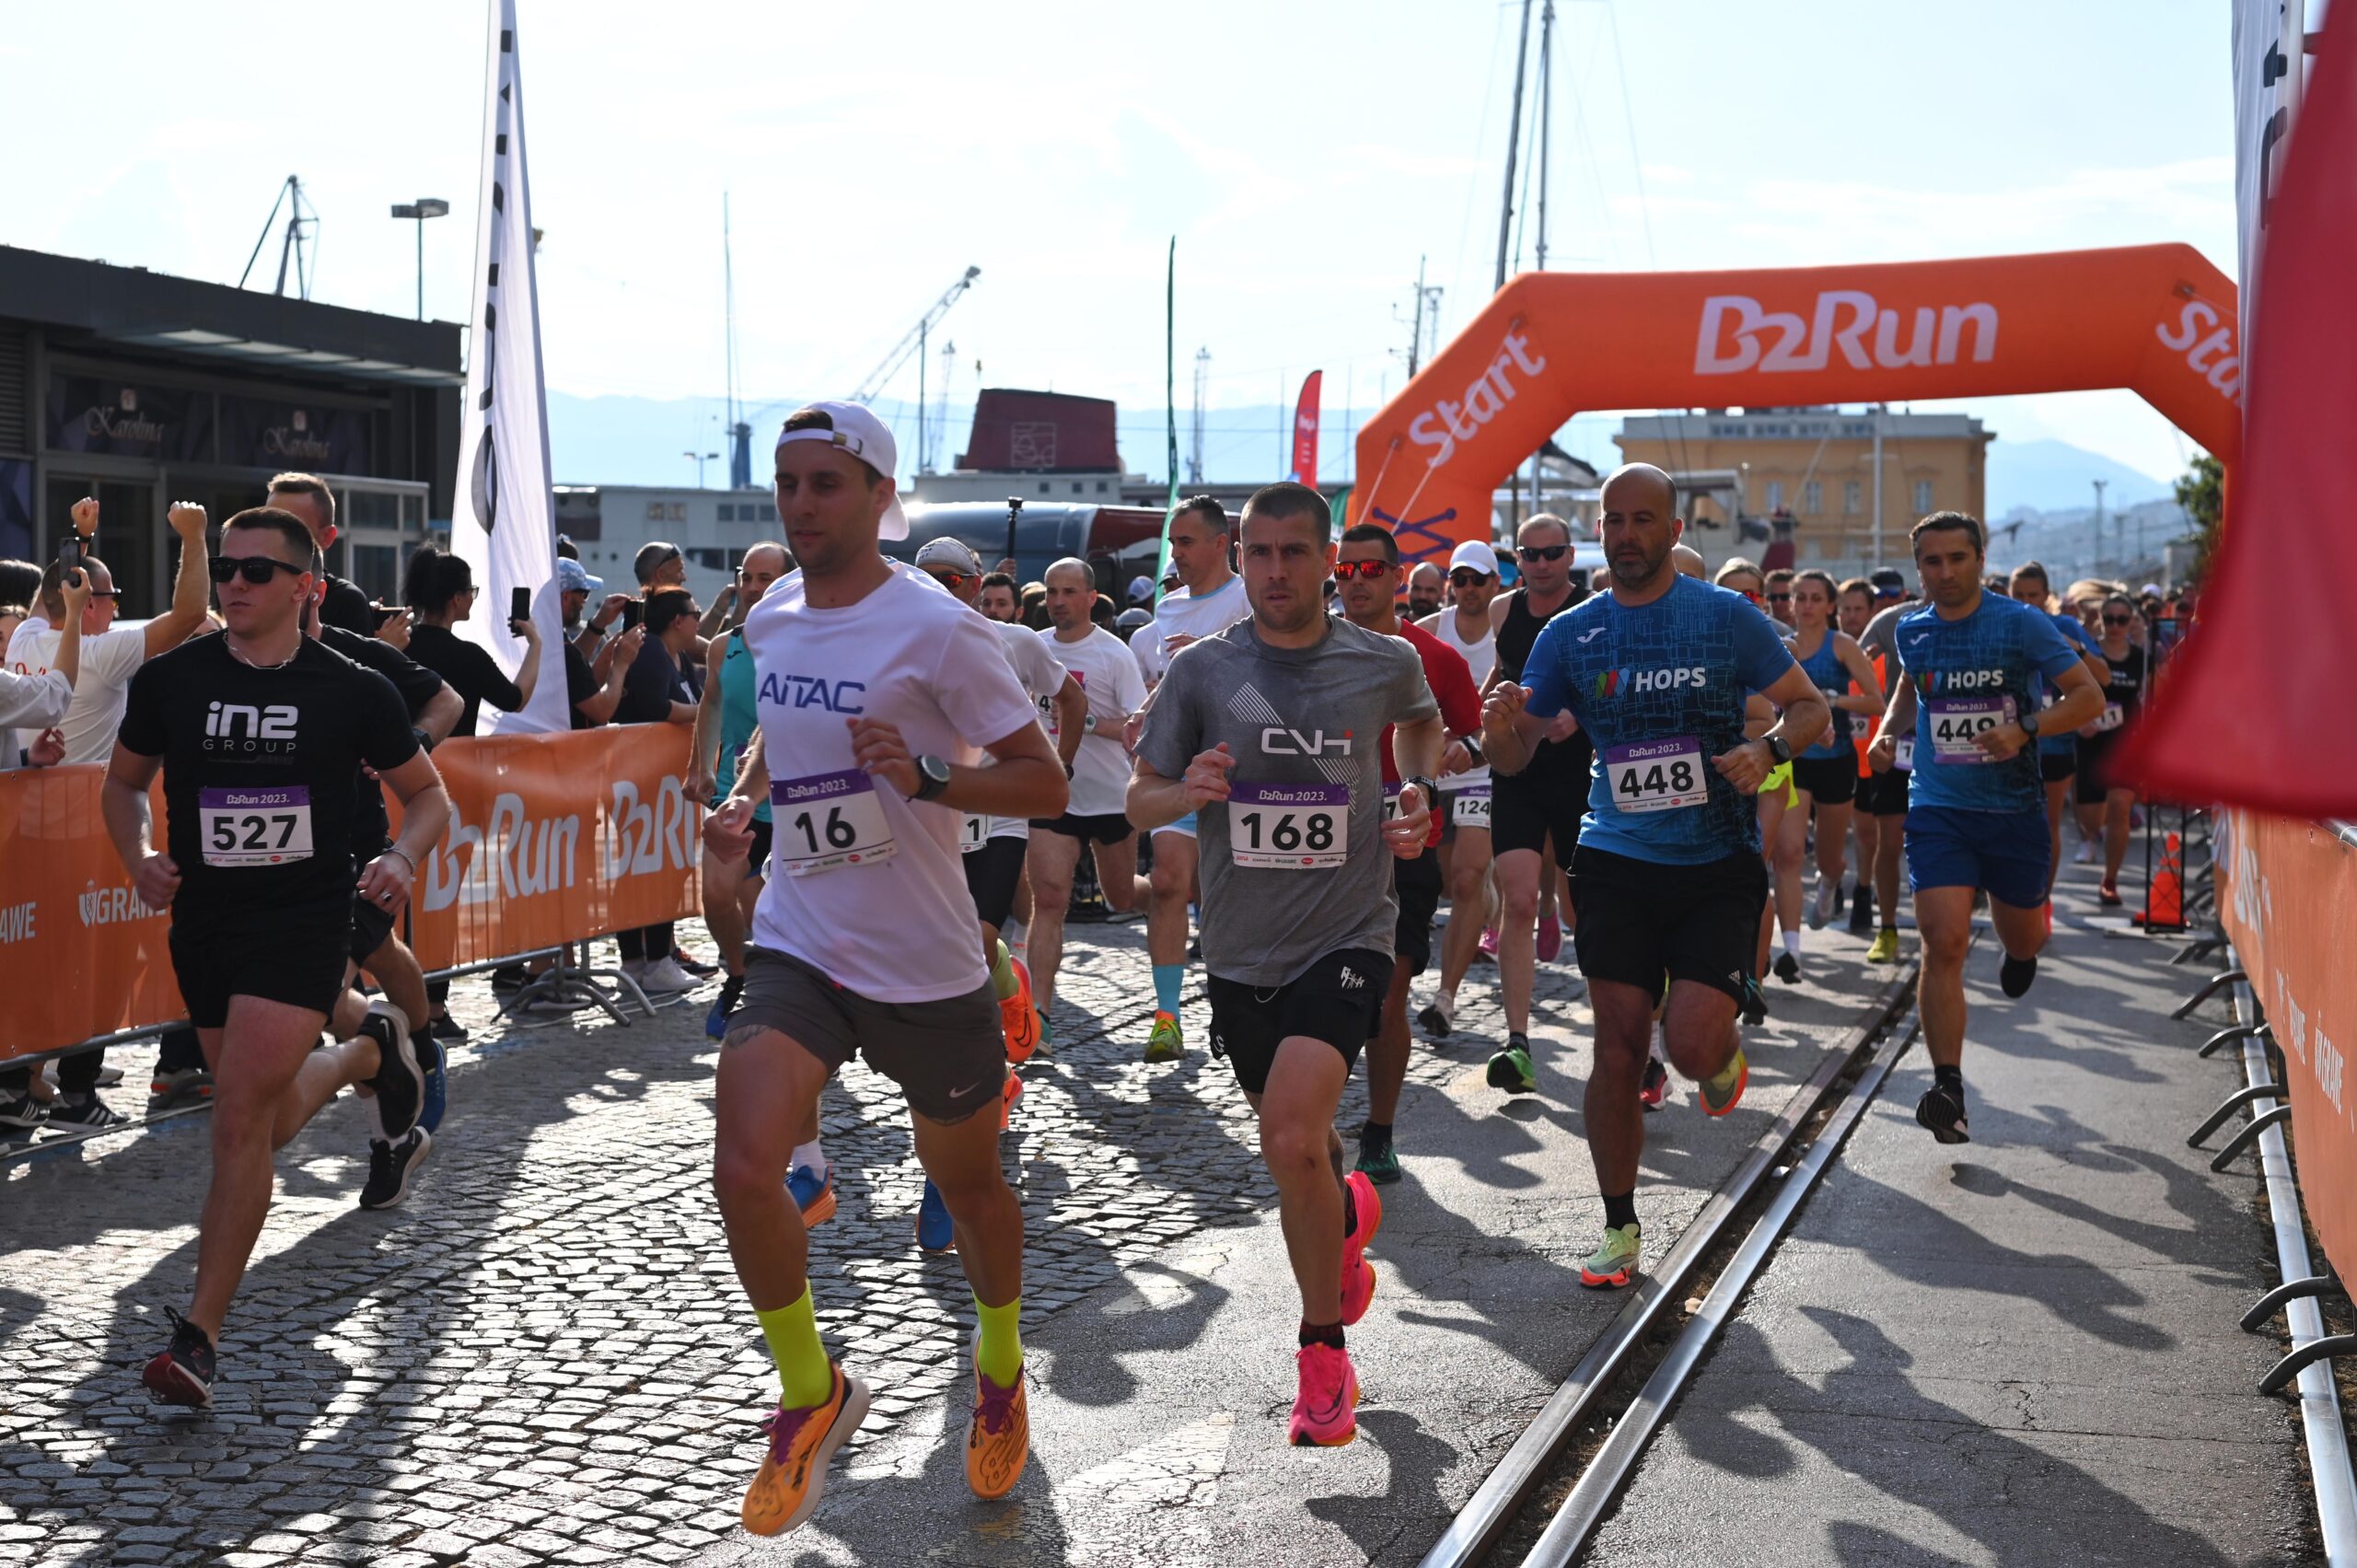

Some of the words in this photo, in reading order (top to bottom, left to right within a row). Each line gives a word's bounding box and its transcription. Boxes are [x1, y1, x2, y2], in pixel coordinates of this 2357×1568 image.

[1693, 289, 1999, 375] B2Run
[2155, 301, 2243, 409] Sta
[1409, 334, 1546, 467] Start
[1635, 667, 1706, 692] HOPS
[1947, 669, 2003, 690] HOPS
[203, 739, 296, 753] GROUP
[1657, 743, 1683, 754] 2023.
[819, 779, 851, 793] 2023.
[1619, 761, 1694, 797] 448
[261, 794, 290, 804] 2023.
[1295, 791, 1328, 801] 2023.
[1458, 800, 1491, 816] 124
[212, 814, 297, 851] 527
[795, 807, 856, 854] 16
[1240, 812, 1333, 851] 168
